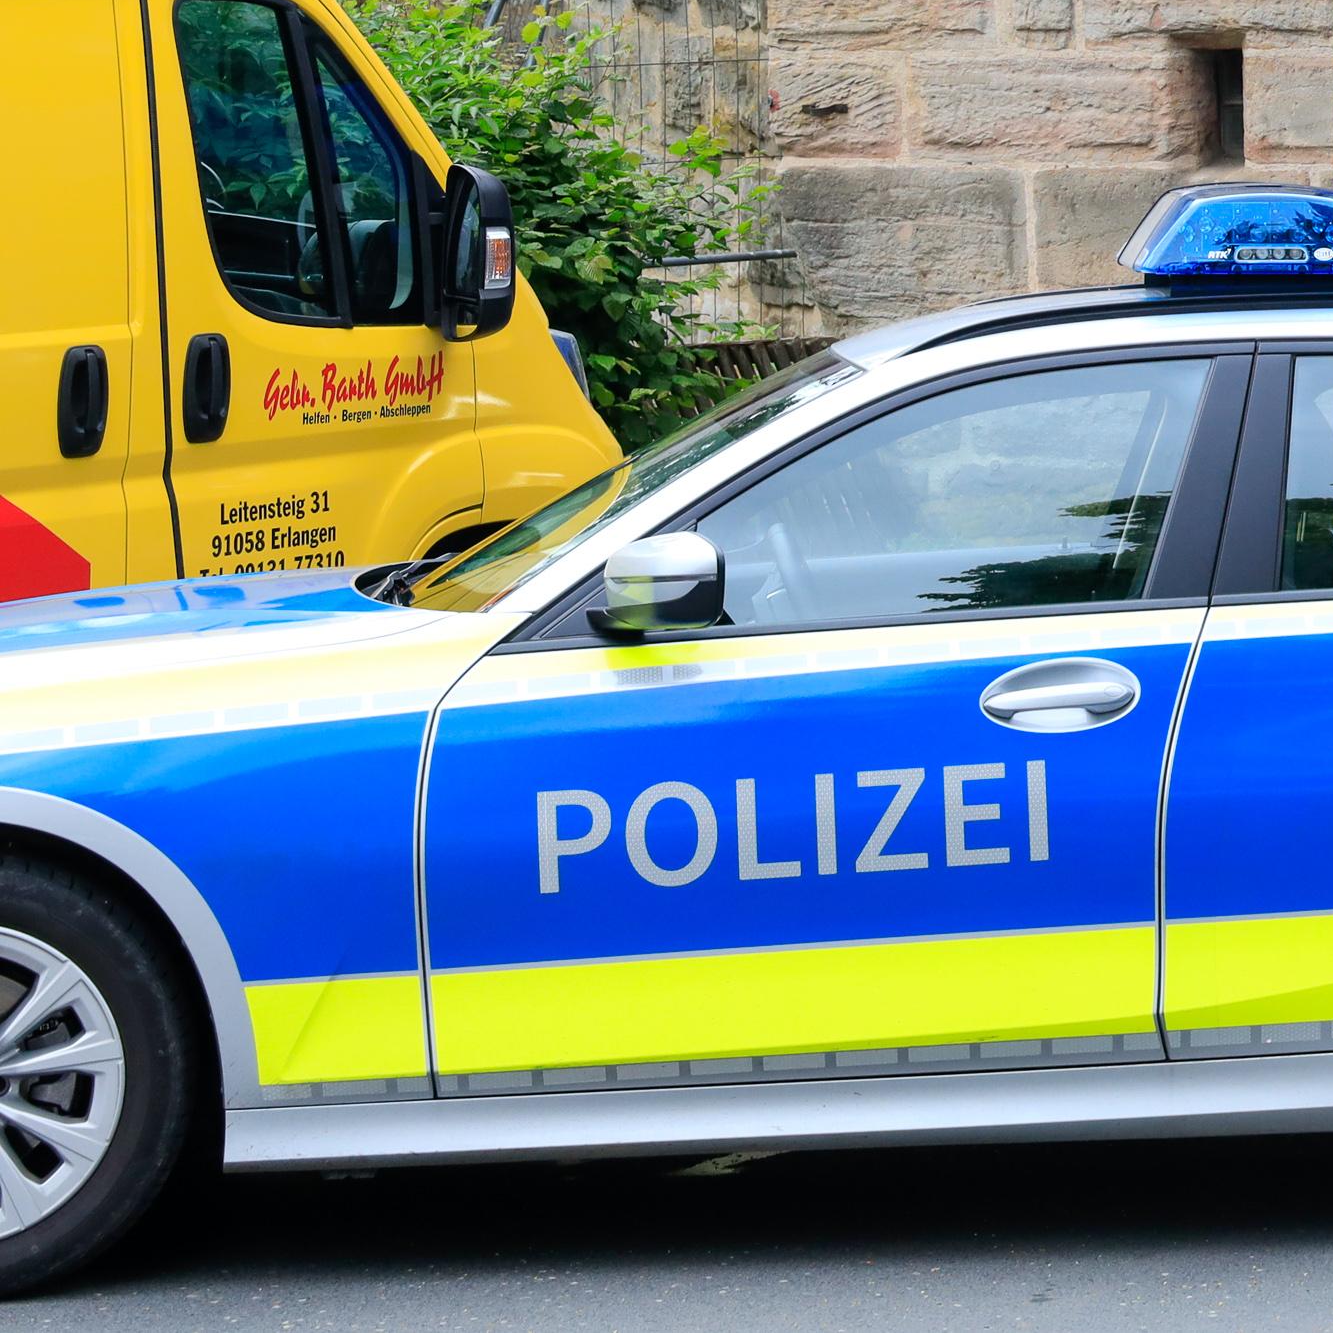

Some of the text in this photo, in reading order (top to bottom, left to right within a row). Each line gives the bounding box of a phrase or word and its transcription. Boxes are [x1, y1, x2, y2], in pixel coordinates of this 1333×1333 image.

[264, 350, 445, 421] Gebr. Barth GmbH
[302, 404, 431, 425] Helfen Bergen Abschleppen
[220, 490, 330, 525] Leitensteig 31
[211, 526, 337, 558] 91058 Erlangen
[537, 759, 1050, 895] POLIZEI
